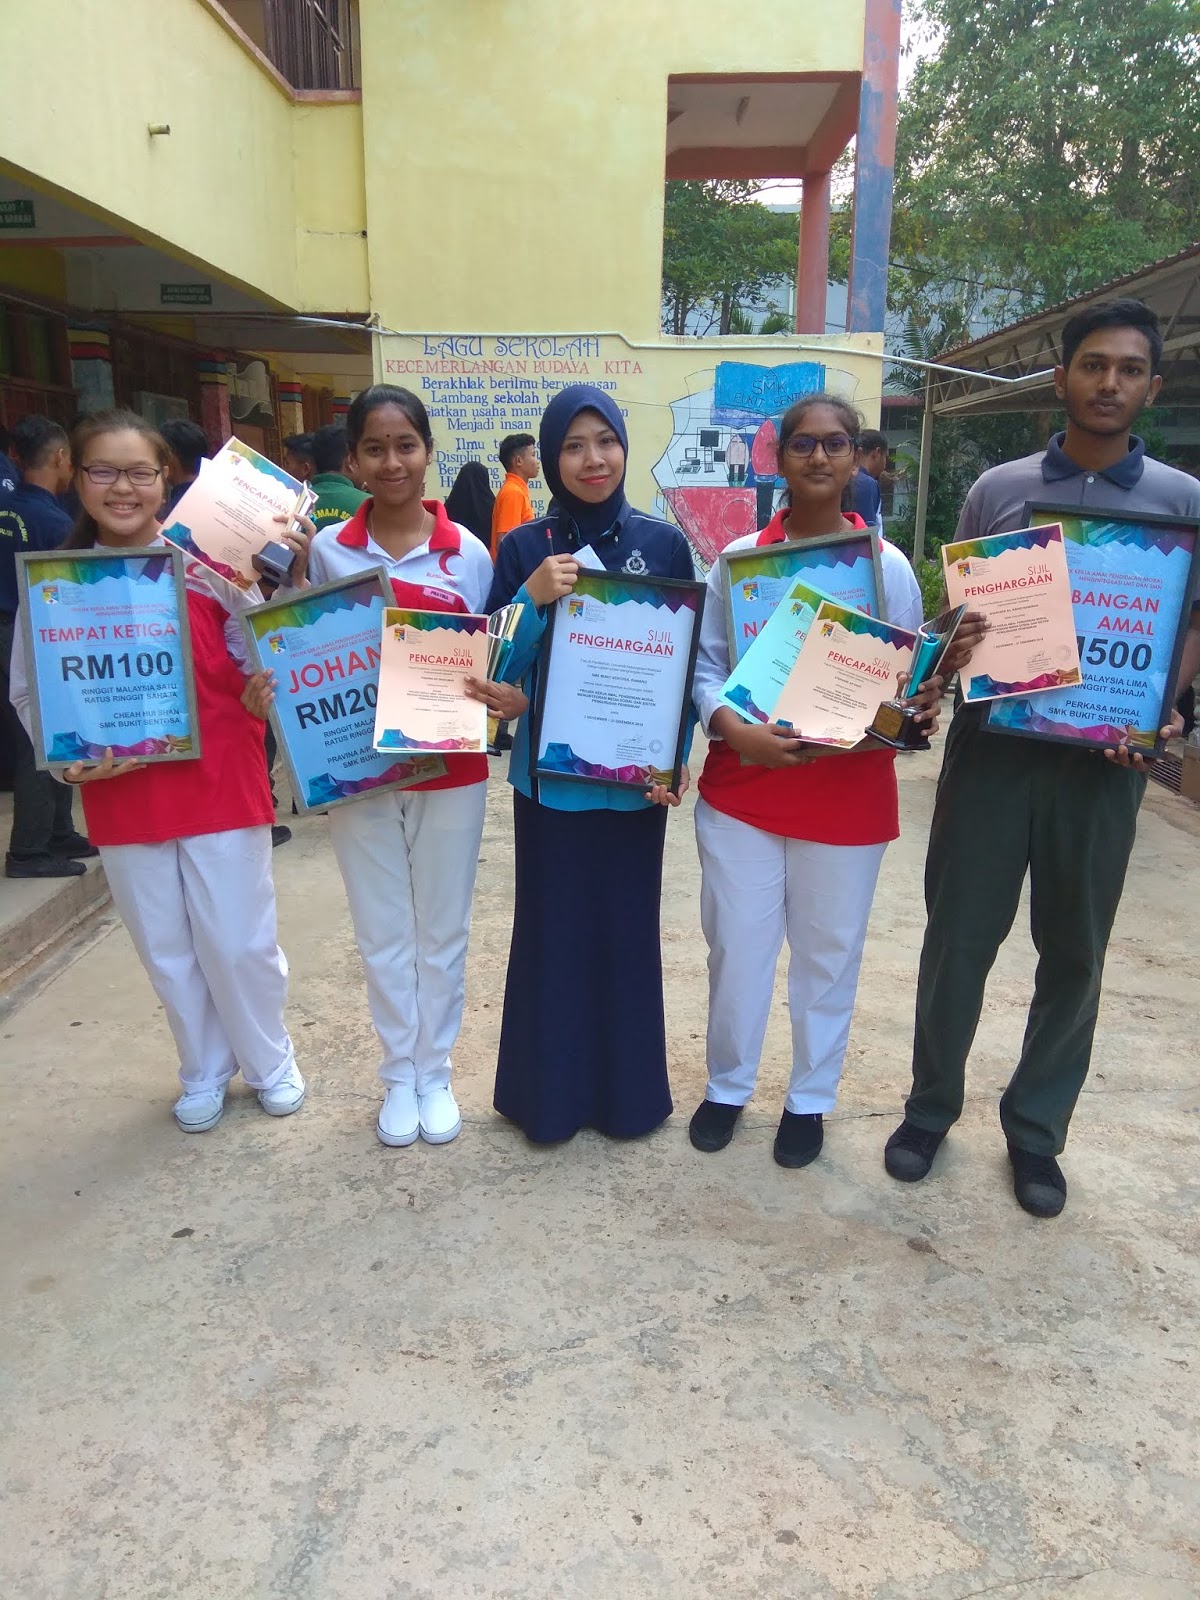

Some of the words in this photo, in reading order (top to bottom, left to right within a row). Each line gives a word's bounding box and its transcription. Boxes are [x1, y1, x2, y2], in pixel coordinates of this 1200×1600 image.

[423, 336, 483, 359] LAGU
[494, 336, 600, 359] SEKOLAH
[385, 360, 527, 374] KECEMERLANGAN
[533, 360, 590, 374] BUDAYA
[604, 360, 643, 374] KITA
[421, 376, 485, 389] Berakhlak
[490, 376, 538, 389] berilmu
[751, 380, 787, 395] SMK
[431, 390, 488, 406] Lambang
[494, 391, 540, 404] sekolah
[733, 391, 766, 408] BUKIT
[773, 389, 811, 408] SENTOS
[471, 404, 506, 417] usaha
[448, 417, 494, 432] Menjadi
[500, 417, 532, 430] insan
[455, 437, 485, 451] Ilmu
[436, 450, 481, 466] Disiplin
[232, 476, 289, 515] PENCAPAIAN
[312, 508, 339, 518] EMAJA
[1027, 563, 1050, 576] SIJIL
[964, 573, 1053, 597] PENGHARGAAN
[1071, 589, 1160, 614] BANGAN
[38, 626, 107, 643] TEMPAT
[113, 622, 177, 639] KETIGA
[1096, 615, 1154, 636] AMAL
[569, 632, 674, 656] PENGHARGAAN
[647, 629, 673, 644] SIJIL
[409, 653, 473, 667] PENCAPAIAN
[453, 647, 473, 658] SIJIL
[61, 650, 173, 682] RM100
[288, 642, 382, 694] JOHAN
[827, 650, 890, 680] PENCAPAIAN
[871, 657, 891, 671] SIJIL
[1081, 673, 1124, 686] MALAYSIA
[1126, 679, 1148, 689] LIMA
[81, 687, 113, 695] RINGGIT
[115, 684, 155, 693] MALAYSIA
[156, 683, 177, 691] SATU
[1109, 687, 1146, 698] SAHAJA
[84, 696, 111, 704] RATUS
[112, 694, 144, 702] RINGGIT
[146, 692, 178, 700] SAHAJA
[113, 711, 140, 719] CHEAH
[158, 708, 180, 716] SHAN
[295, 683, 378, 730] RM20
[1065, 700, 1108, 712] PERKASA
[1109, 706, 1142, 717] MORAL
[118, 719, 142, 728] BUKIT
[143, 717, 181, 726] SENTOSA
[1048, 707, 1067, 716] SMK
[1069, 710, 1096, 720] BUKIT
[1097, 714, 1140, 727] SENTOSA
[323, 724, 353, 738] RINGGIT
[324, 735, 349, 747] RATUS
[349, 727, 375, 739] RINGG
[327, 750, 358, 764] PRAVINA
[342, 758, 360, 769] SMK
[360, 752, 381, 763] BUKIT
